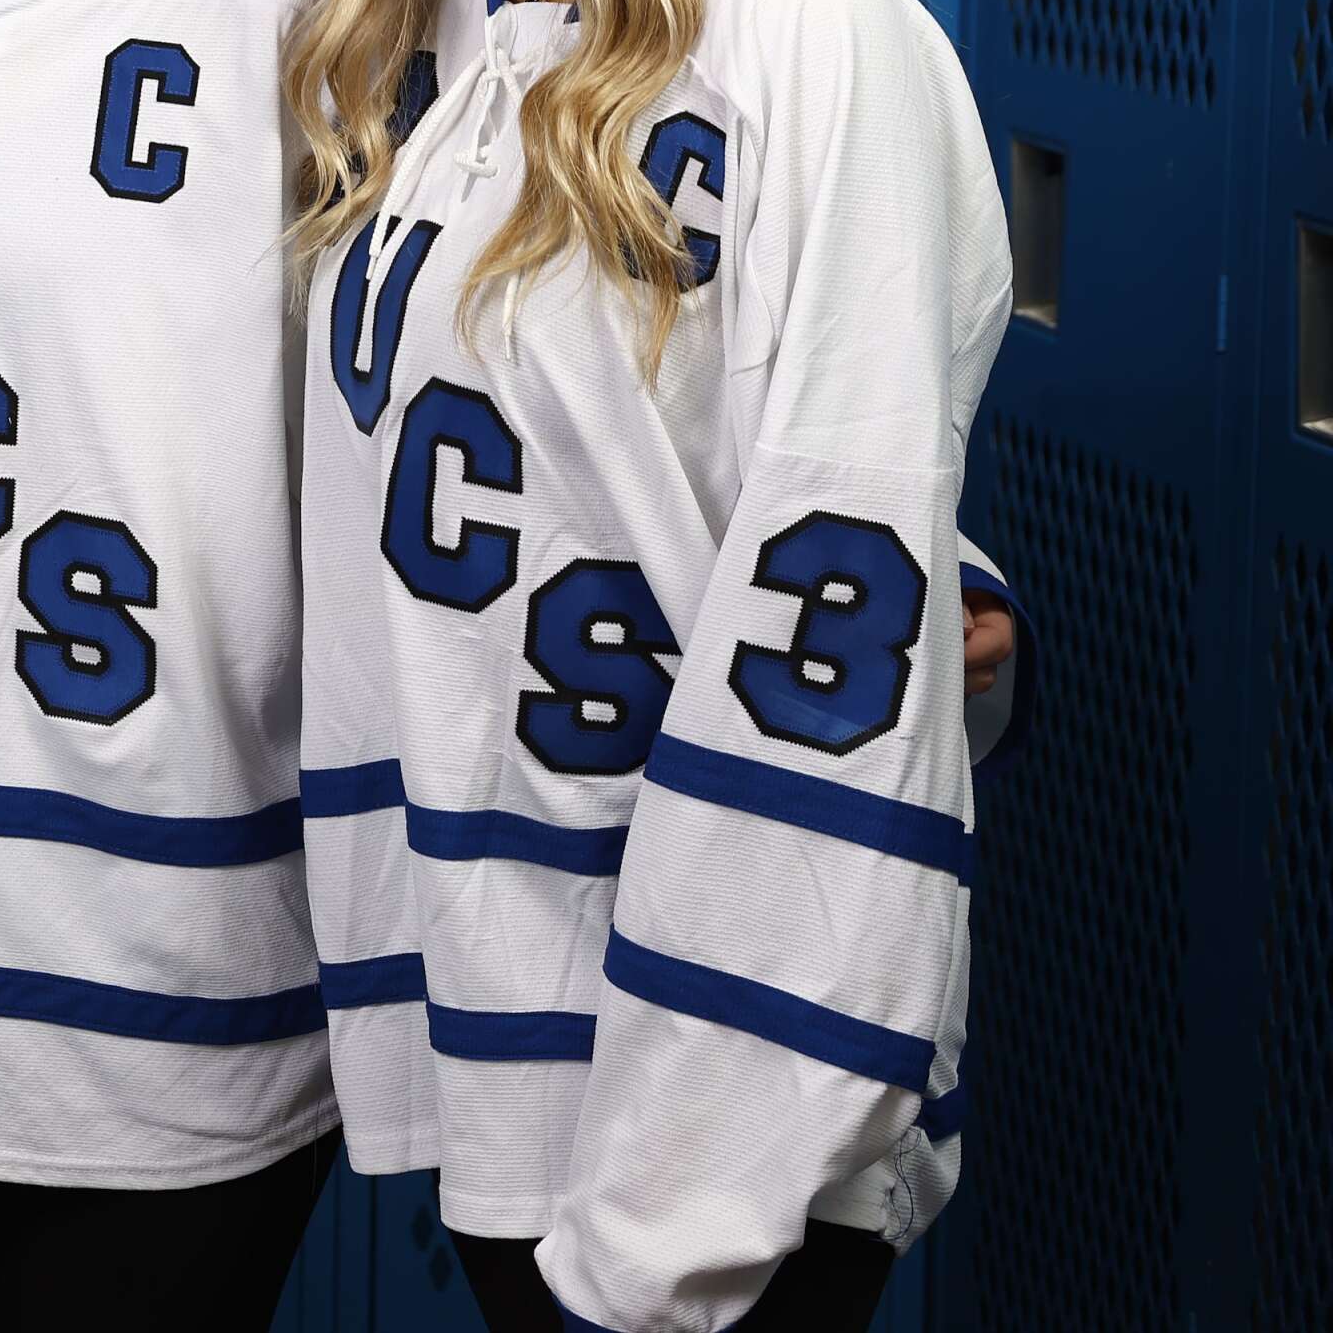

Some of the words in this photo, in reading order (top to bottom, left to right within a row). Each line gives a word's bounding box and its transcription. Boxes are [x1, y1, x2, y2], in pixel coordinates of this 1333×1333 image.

[90, 38, 200, 203] C
[308, 50, 679, 776] UCS
[728, 509, 928, 757] 3
